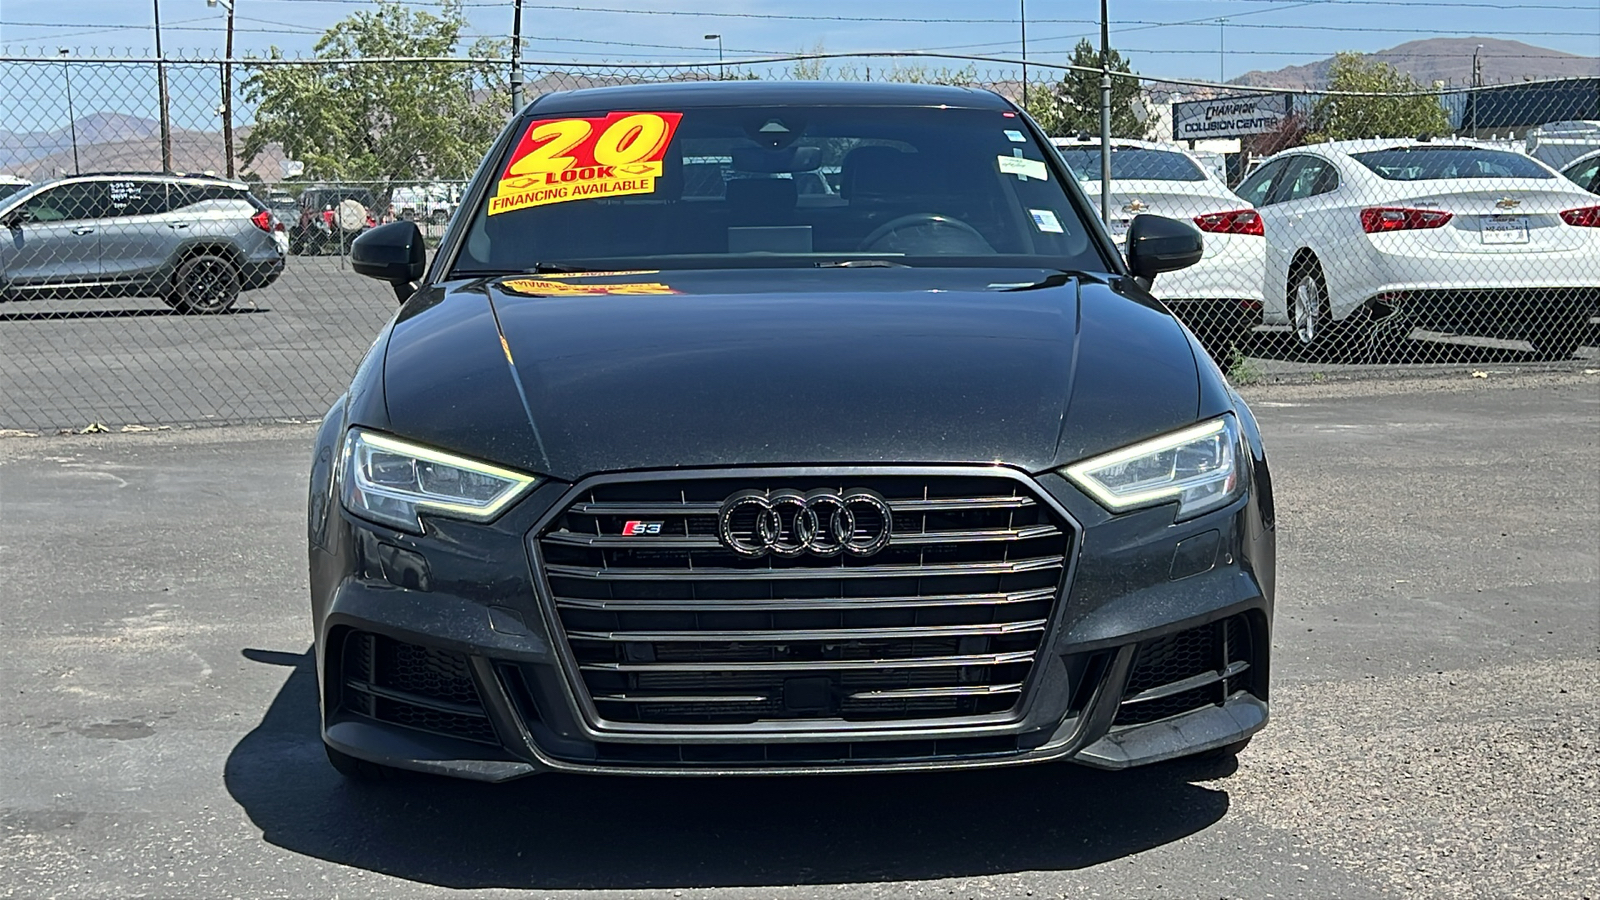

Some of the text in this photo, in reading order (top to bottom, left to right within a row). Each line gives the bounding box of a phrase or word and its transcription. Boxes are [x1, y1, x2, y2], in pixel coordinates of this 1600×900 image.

[1205, 102, 1256, 120] CHAMPION
[1185, 116, 1278, 133] COLLISION CENTER
[509, 114, 669, 177] 20
[545, 165, 616, 185] LOOK
[492, 179, 649, 210] FINANCING AVAILABLE
[632, 523, 661, 534] S3
